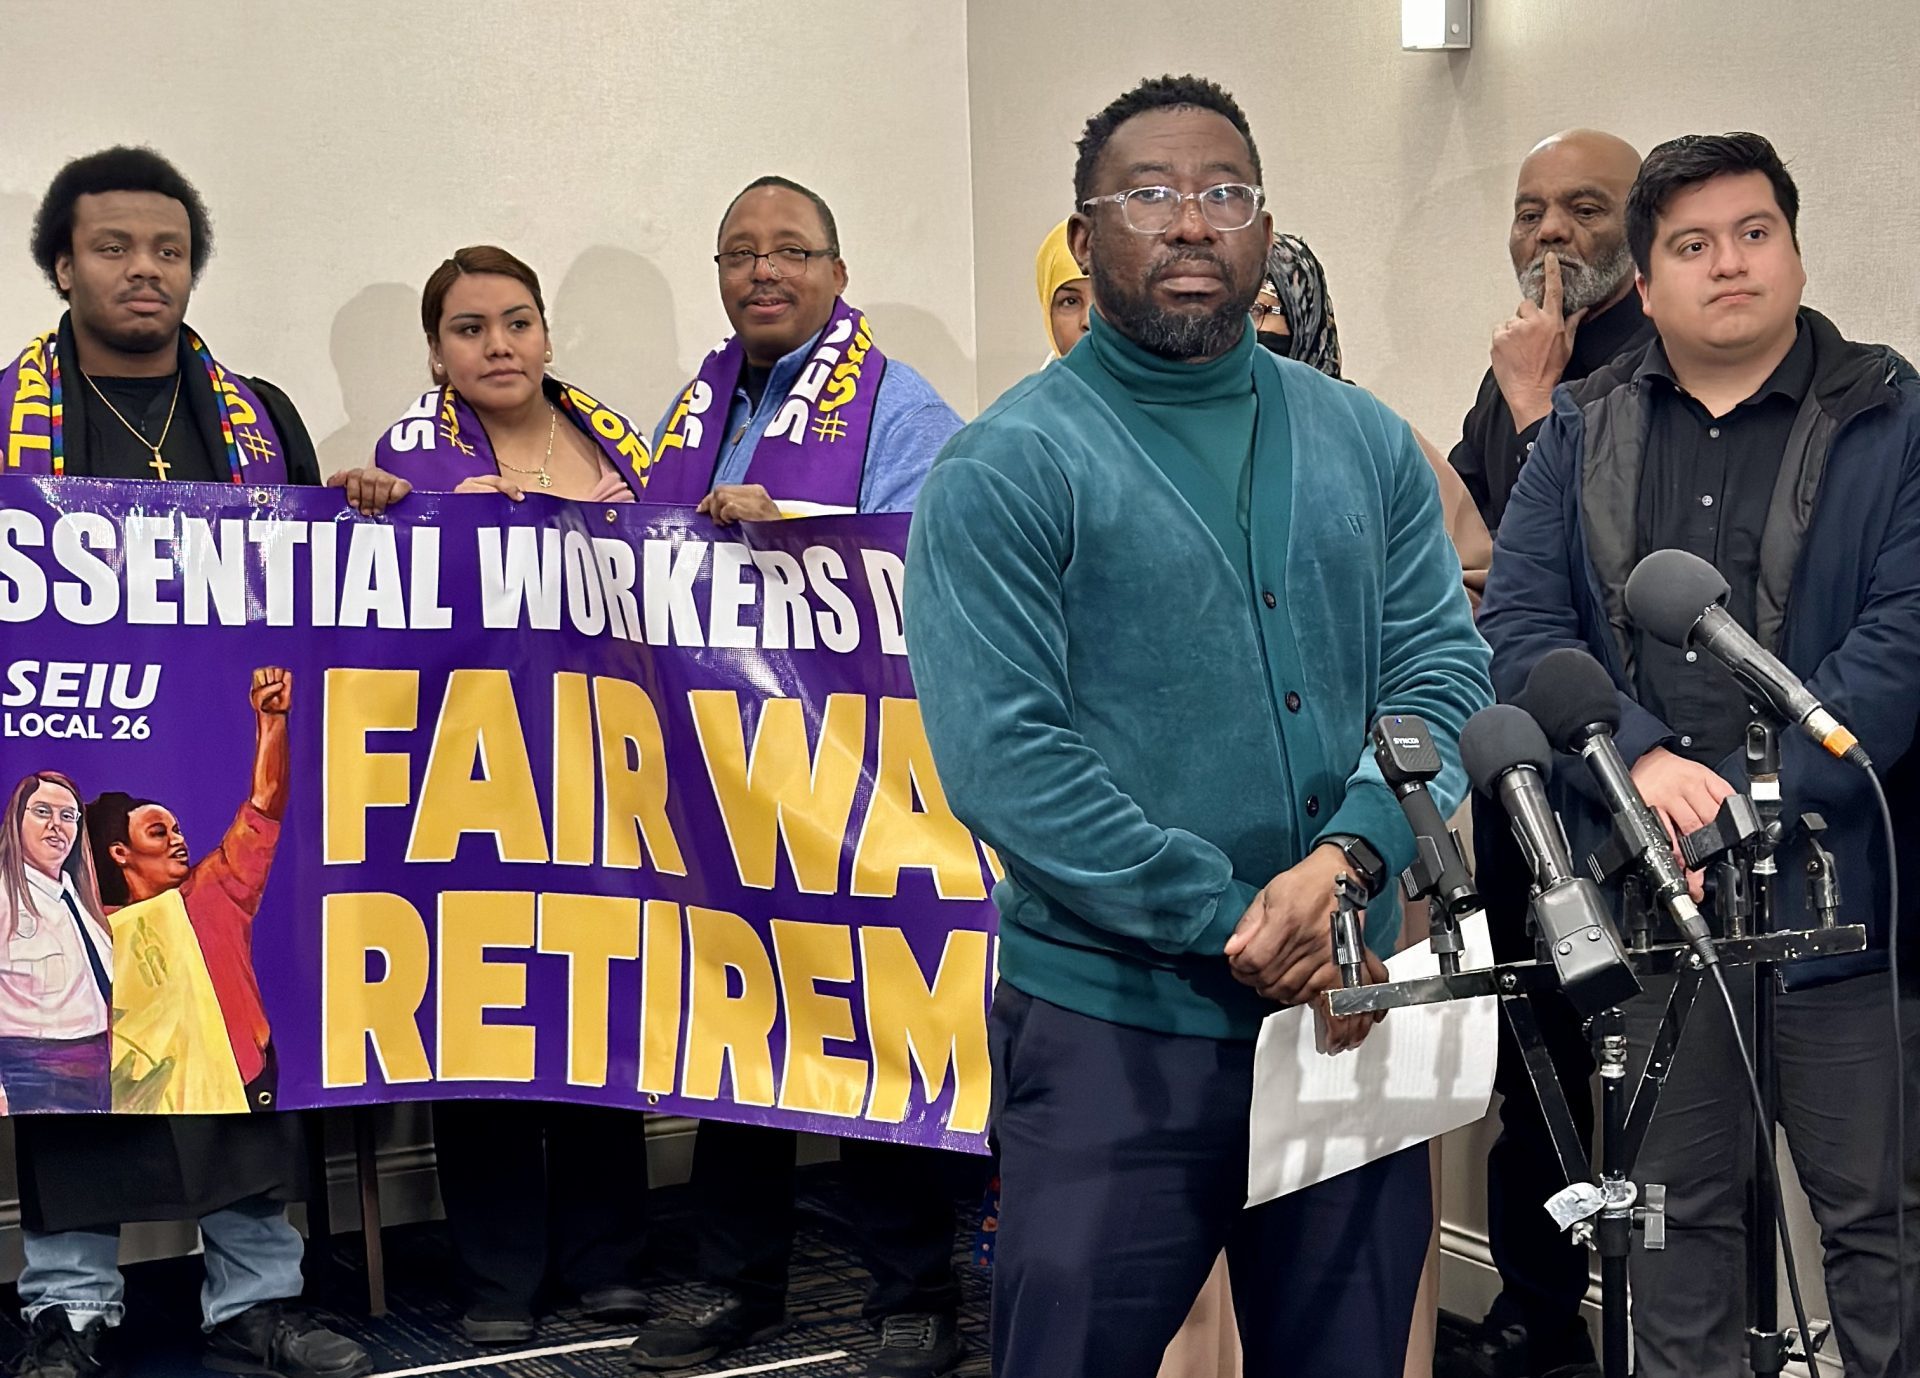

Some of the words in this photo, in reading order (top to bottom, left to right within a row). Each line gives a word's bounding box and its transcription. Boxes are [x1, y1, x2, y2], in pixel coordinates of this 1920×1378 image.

[390, 385, 442, 452] SE
[567, 387, 651, 488] FOR
[0, 509, 453, 629] SSENTIAL
[477, 526, 861, 653] WORKERS
[2, 660, 161, 709] SEIU
[4, 712, 103, 739] LOCAL
[112, 714, 151, 740] 26
[323, 667, 687, 876] FAIR
[687, 689, 1005, 900] WA
[322, 891, 1000, 1134] RETIREM
